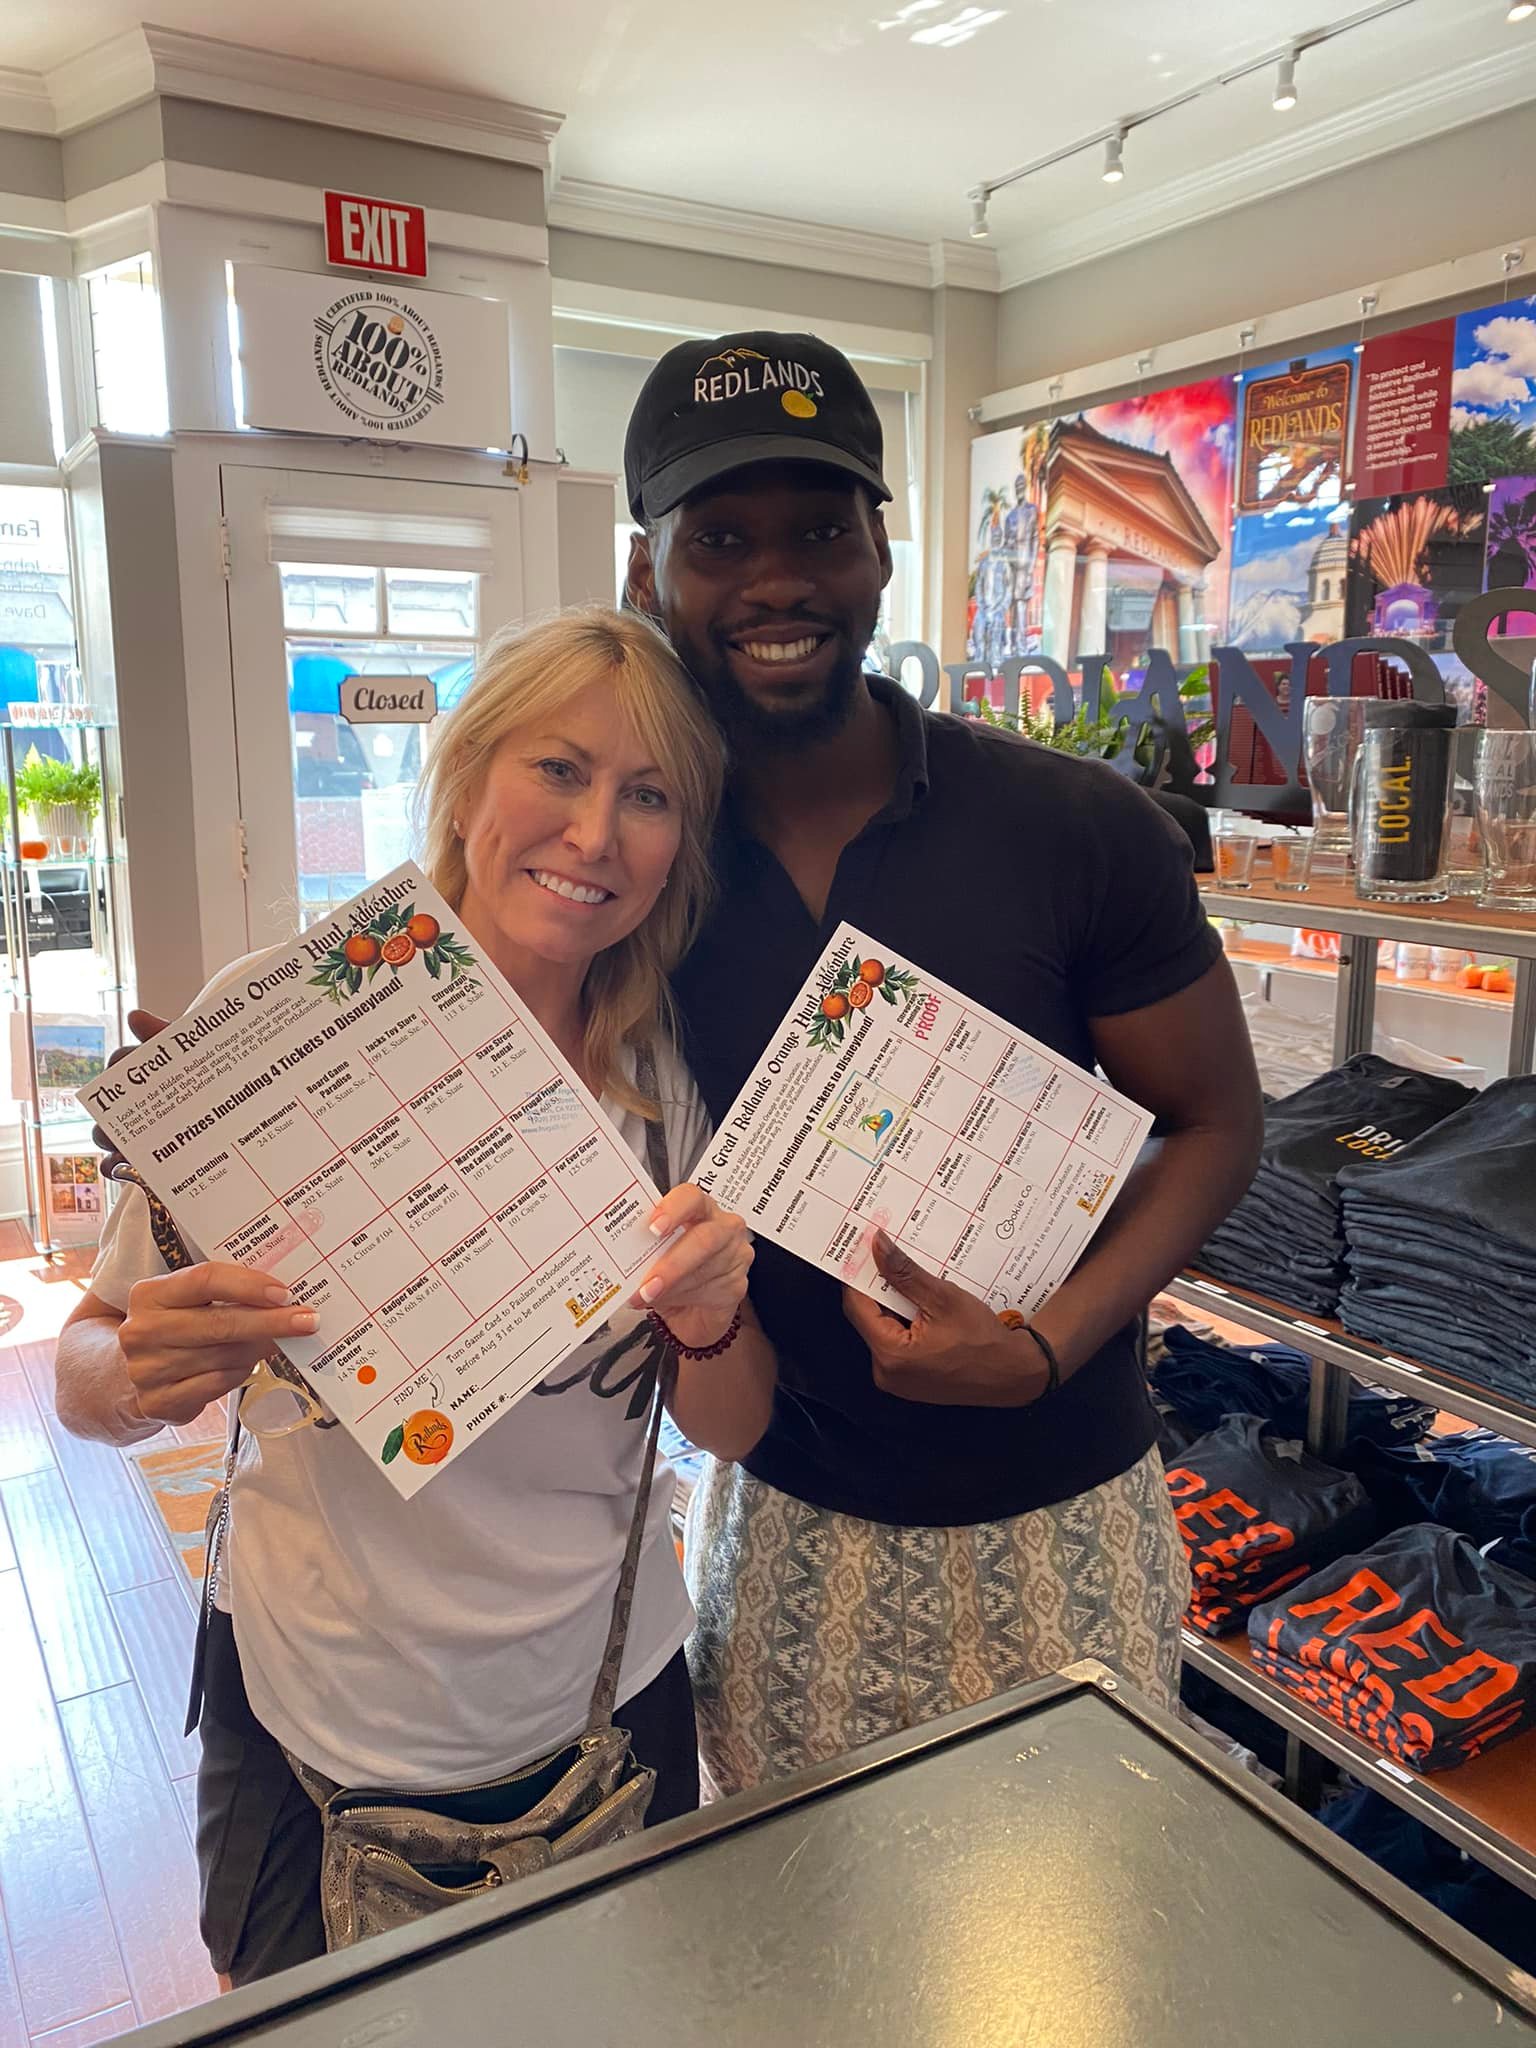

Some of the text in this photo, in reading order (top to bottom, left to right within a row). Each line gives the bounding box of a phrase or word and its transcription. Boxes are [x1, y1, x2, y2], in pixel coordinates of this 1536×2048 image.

[341, 200, 409, 268] EXIT
[325, 291, 442, 389] CERTIFIED 100% ABOUT REDLANDS
[346, 310, 427, 377] 100%
[314, 334, 332, 391] REDLANDS
[331, 339, 423, 405] ABOUT
[694, 359, 825, 402] REDLANDS
[1409, 360, 1425, 373] and
[331, 359, 409, 414] REDLANDS
[1263, 382, 1329, 409] Welcome to
[329, 391, 359, 422] ABOUT
[387, 403, 432, 431] CERTIFIED
[1250, 402, 1342, 453] REDLANDS
[353, 687, 424, 711] Closed
[87, 876, 418, 1112] The Great Redlands Orange Hunt Adventure
[437, 989, 466, 1011] Printing
[365, 1013, 416, 1052] Jacks Toy Store
[915, 993, 941, 1041] PROOF
[475, 1028, 514, 1059] State Street
[490, 1042, 513, 1062] Dental
[151, 976, 403, 1163] Fun Prizes Including 4 Tickets to Disneyland!
[305, 1061, 349, 1094] Board Game
[698, 936, 856, 1194] The Great Redlands Orange Hunt Adventure
[319, 1073, 352, 1098] Paradise
[409, 1067, 463, 1110] Daryl's Pet Shop
[508, 1076, 565, 1122] The Frugal Frigate
[237, 1100, 297, 1146] Sweet Memories
[751, 1015, 874, 1215] Fun Prizes Including 4 Tickets to Disneyland!
[842, 1096, 868, 1129] Paradise
[350, 1115, 400, 1154] Dirtbag Coffee
[371, 1129, 399, 1152] Leather
[454, 1125, 504, 1166] Martha Green's
[459, 1132, 513, 1175] The Eating Room
[171, 1151, 229, 1195] Nectar Clothing
[308, 1175, 323, 1187] Ice
[321, 1157, 346, 1178] Cream
[554, 1136, 598, 1173] For Ever Green
[405, 1183, 448, 1218] Called Quest
[412, 1182, 432, 1199] Shop
[495, 1178, 547, 1222] Bricks and Birch
[604, 1197, 627, 1219] Paulson
[223, 1214, 270, 1251] The Gourmet
[604, 1199, 639, 1232] Orthodontics
[1000, 1200, 1024, 1236] Cookie
[231, 1223, 279, 1260] Pizza Shoppe
[351, 1232, 368, 1247] Kith
[440, 1227, 487, 1266] Cookie Corner
[298, 1278, 328, 1303] Kitchen
[381, 1275, 429, 1315] Badger Bowls
[445, 1249, 576, 1363] Turn Game Card to Paulson Orthodontics
[311, 1321, 373, 1372] Redlands Visitors
[336, 1344, 361, 1366] Center
[393, 1385, 413, 1405] FIND
[449, 1384, 479, 1410] NAME:
[466, 1400, 498, 1430] PHONE
[407, 1418, 449, 1456] Redlands
[1289, 1568, 1519, 1720] RED
